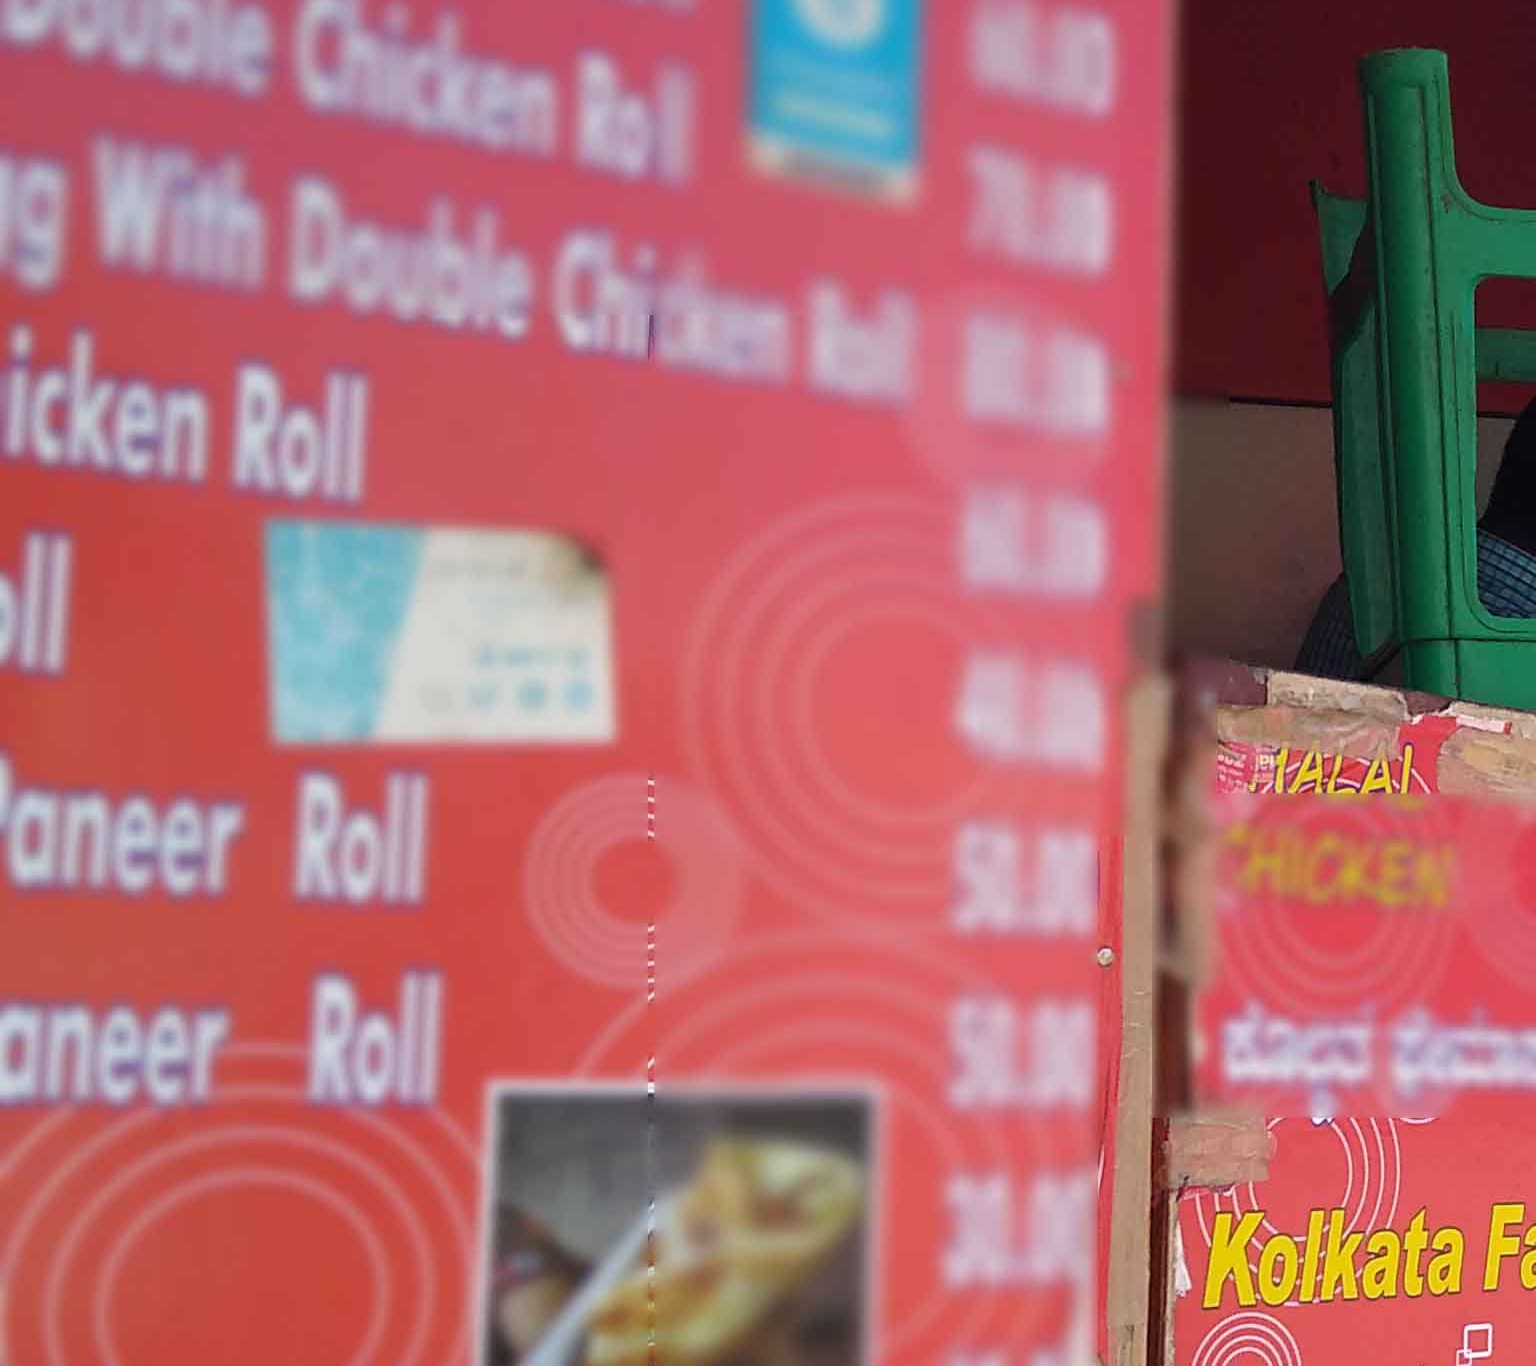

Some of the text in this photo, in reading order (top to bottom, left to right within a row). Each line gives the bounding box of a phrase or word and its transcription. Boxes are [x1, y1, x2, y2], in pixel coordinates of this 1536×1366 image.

[233, 361, 368, 501] Roll
[0, 747, 430, 905] aneer Roll
[308, 969, 443, 1105] Roll
[1202, 1207, 1464, 1310] Kolkata
